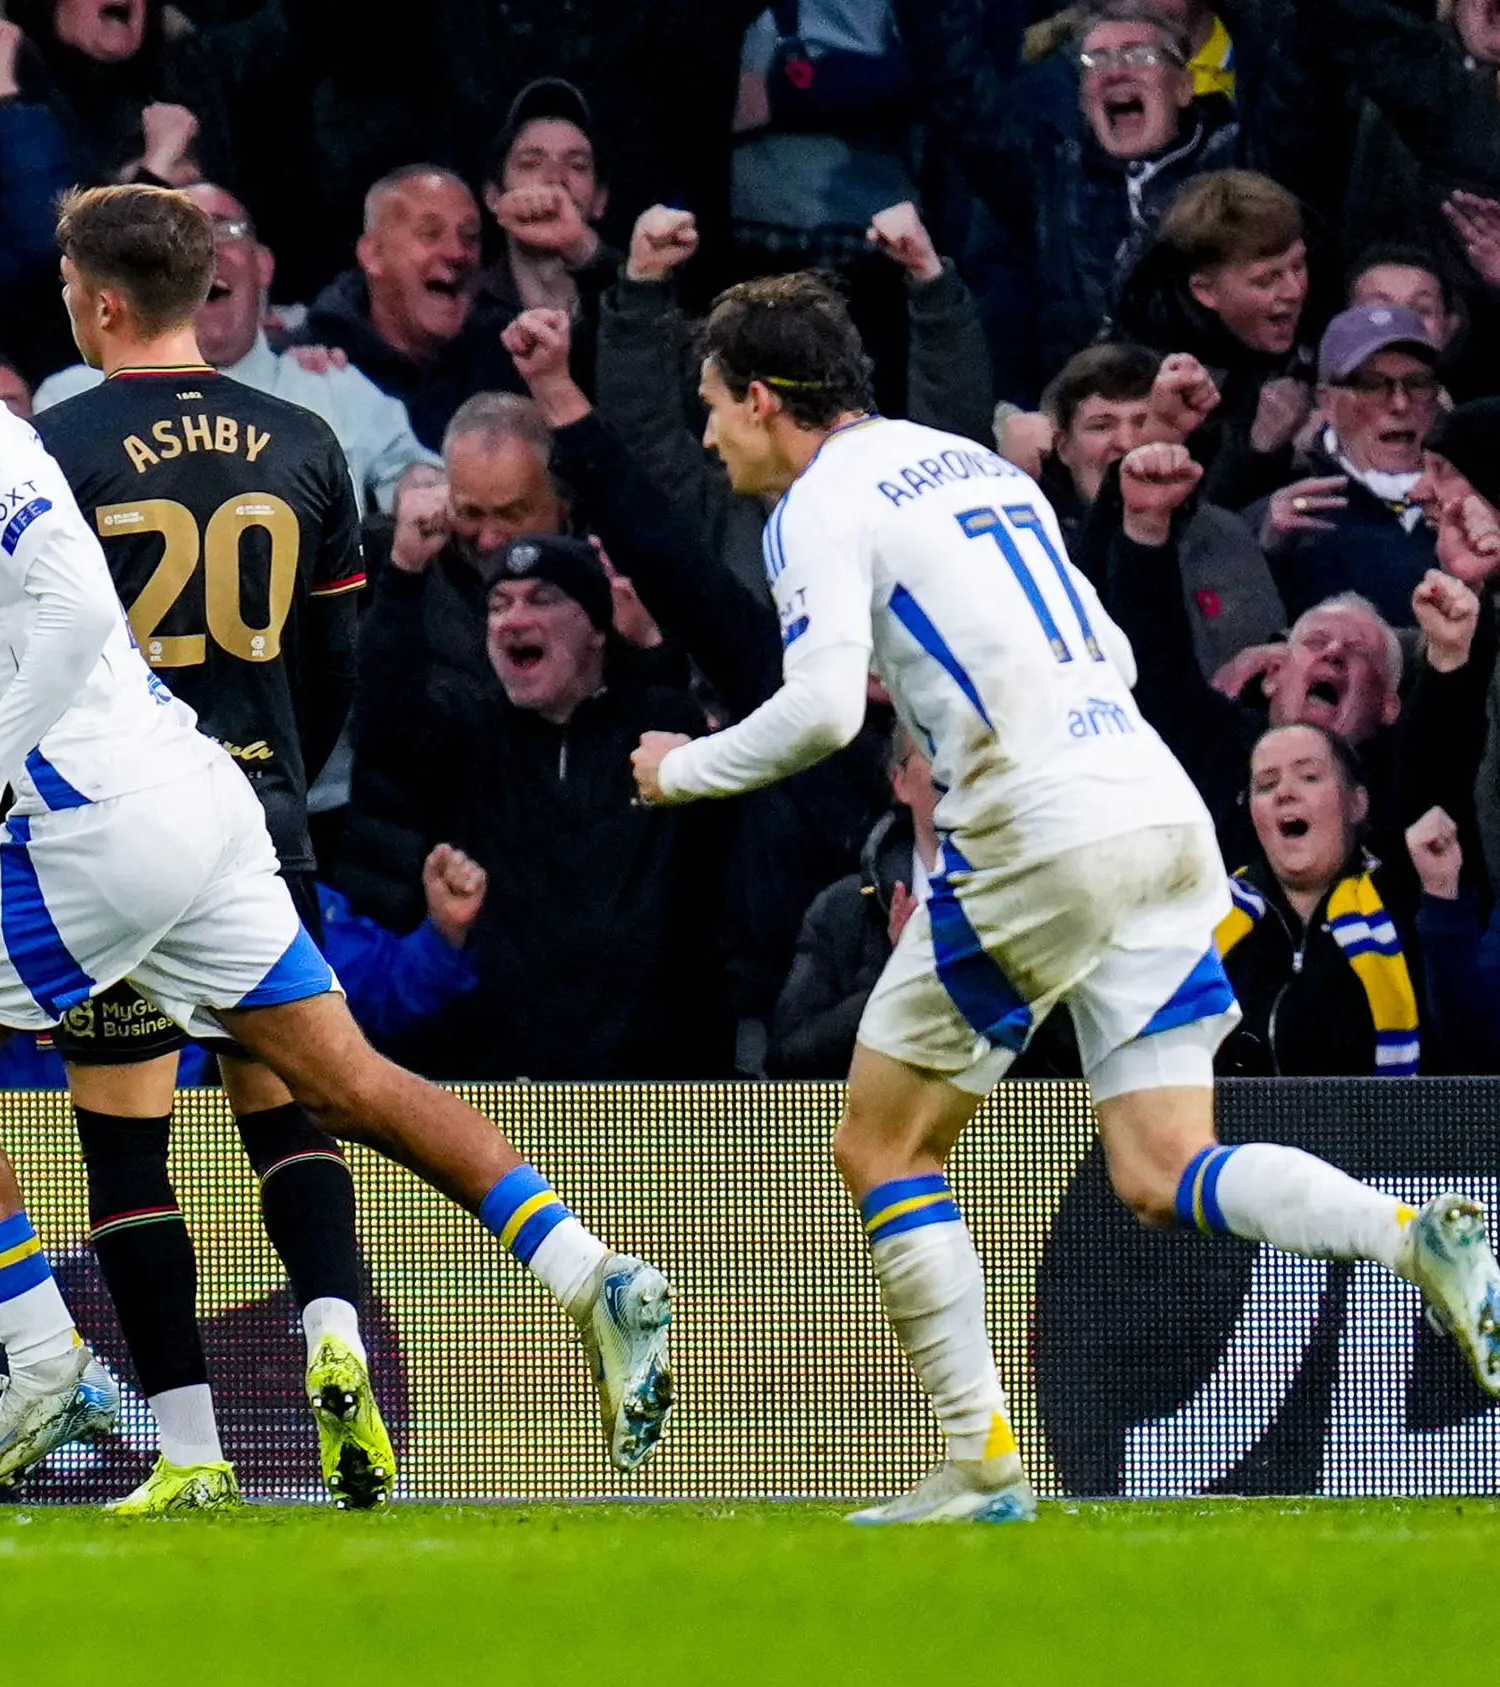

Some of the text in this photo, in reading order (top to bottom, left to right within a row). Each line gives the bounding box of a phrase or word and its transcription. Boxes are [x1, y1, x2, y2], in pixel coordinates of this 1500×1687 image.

[123, 414, 271, 474] ASHBY
[4, 500, 43, 544] LIFE
[95, 491, 300, 668] 20
[954, 503, 1106, 664] 11
[103, 1017, 175, 1037] Busines
